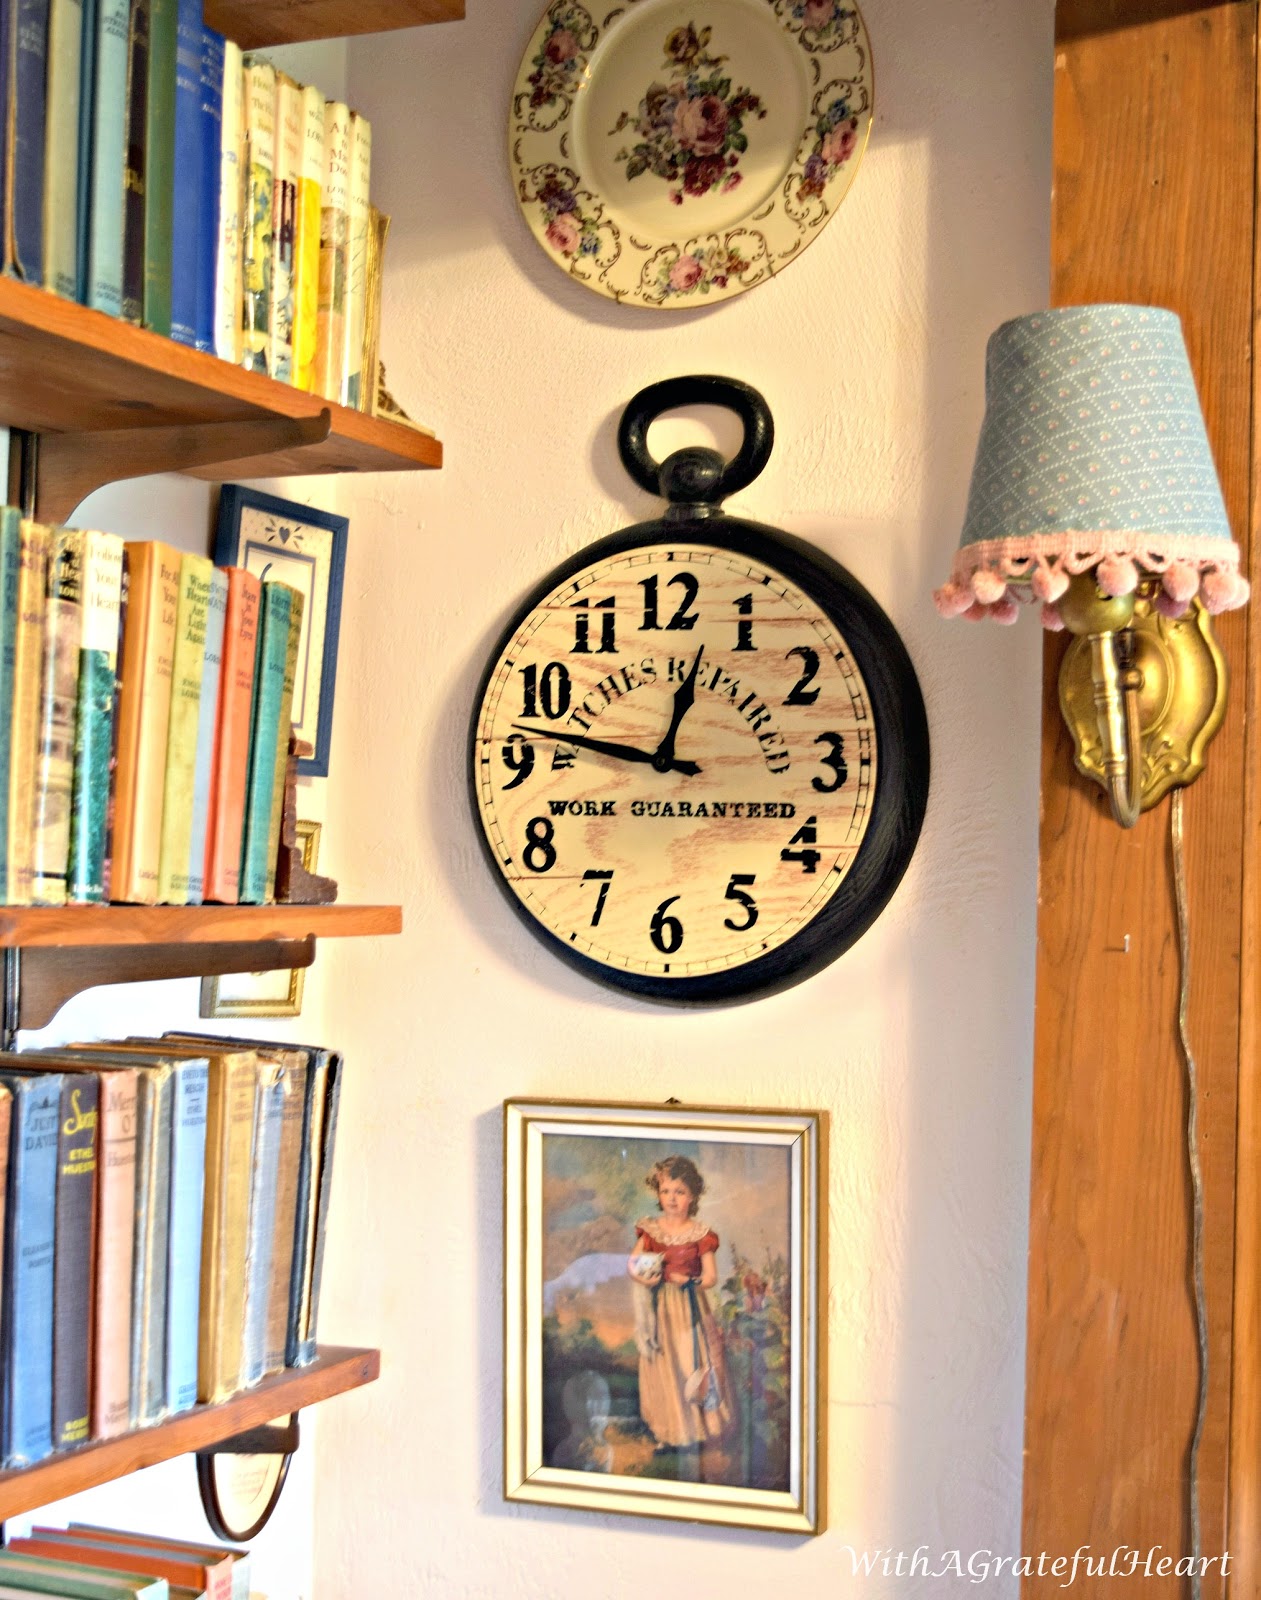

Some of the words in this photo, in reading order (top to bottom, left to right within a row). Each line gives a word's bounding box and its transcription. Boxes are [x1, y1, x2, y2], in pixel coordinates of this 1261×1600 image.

[569, 595, 620, 653] 11
[637, 572, 699, 631] 12
[732, 593, 759, 652] 1
[518, 661, 572, 720] 10
[782, 646, 822, 706] 2
[551, 657, 658, 773] WTCHES
[501, 733, 536, 790] 9
[811, 731, 849, 793] 3
[548, 800, 617, 817] WORK
[631, 801, 797, 820] GUARANTEED
[522, 816, 557, 873] 8
[780, 815, 821, 874] 4
[580, 869, 615, 927] 7
[650, 895, 684, 954] 6
[724, 874, 759, 931] 5
